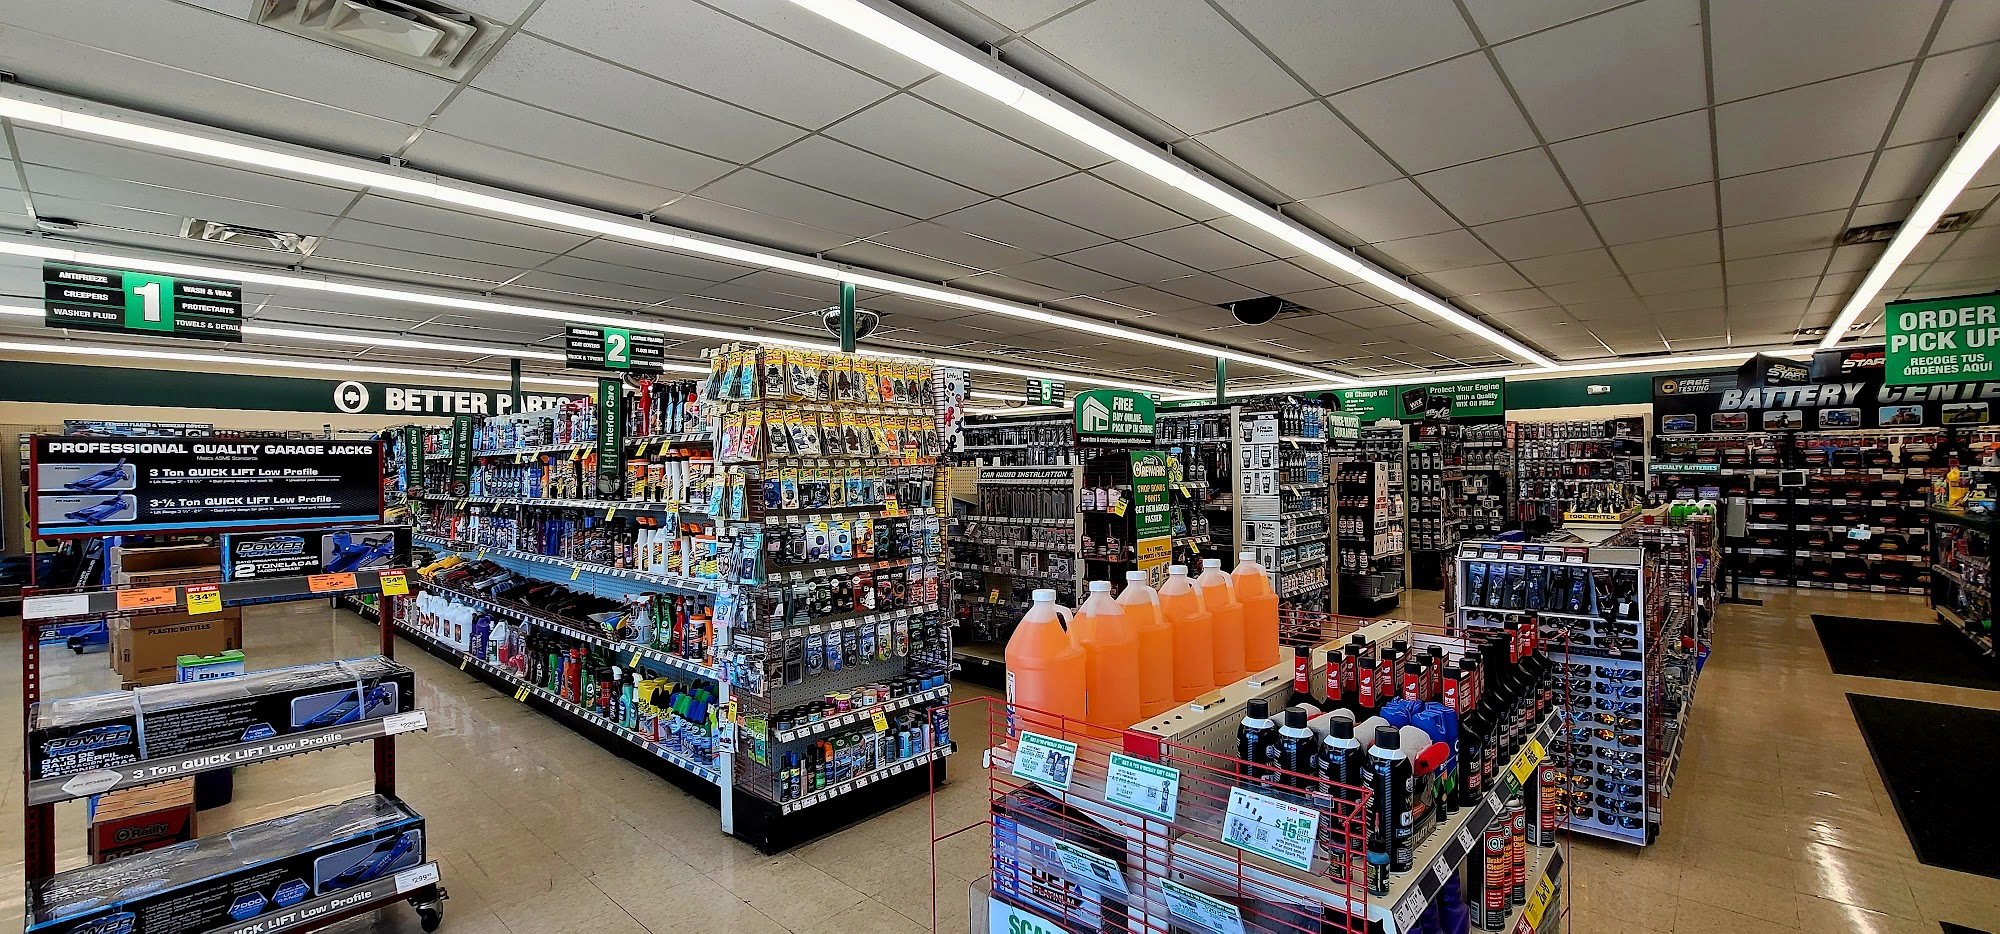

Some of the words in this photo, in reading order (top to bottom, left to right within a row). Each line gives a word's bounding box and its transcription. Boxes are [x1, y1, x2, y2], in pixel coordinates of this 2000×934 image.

[59, 271, 108, 283] ANTIFREEZE
[63, 290, 108, 301] CREEPERS
[183, 286, 206, 295] WASH
[215, 290, 232, 298] WAX
[133, 282, 160, 322] 1
[182, 303, 234, 314] PROTECTANTS
[53, 308, 91, 318] WASHER
[92, 311, 117, 320] FLUID
[1900, 305, 1996, 331] ORDER
[175, 319, 206, 328] TOWELS
[215, 323, 241, 332] DETAIL
[1891, 330, 1957, 353] PICK
[1966, 327, 2000, 347] UP
[607, 334, 626, 362] 2
[1841, 358, 1886, 368] STAR
[1911, 355, 1957, 366] RECOGE
[1960, 353, 1985, 362] TUS
[1767, 368, 1807, 379] START
[1904, 365, 1959, 376] ÓRDENES
[1962, 361, 1993, 372] AQUÍ
[1042, 384, 1051, 401] 5
[1430, 386, 1455, 394] Protect
[1475, 383, 1500, 391] Engine
[385, 387, 488, 413] BETTER
[605, 384, 615, 408] Care
[1719, 382, 1866, 410] BATTERY
[1877, 383, 2000, 403] CENTE
[1113, 396, 1133, 411] FREE
[1112, 412, 1123, 422] BUY
[605, 413, 614, 447] Interior
[1112, 423, 1124, 433] PICK
[1125, 424, 1132, 432] UP
[49, 442, 188, 454] PROFESSIONAL
[193, 444, 260, 455] QUALITY
[264, 445, 324, 455] GARAGE
[328, 445, 373, 455] JACKS
[150, 469, 159, 477] 3
[162, 469, 184, 477] Ton
[188, 469, 227, 477] QUICK
[283, 468, 318, 476] Profile
[1137, 485, 1150, 493] SHOP
[179, 498, 200, 507] Ton
[204, 497, 243, 505] QUICK
[273, 496, 295, 504] Low
[298, 495, 331, 503] Profile
[1145, 514, 1162, 523] FASTER
[236, 541, 304, 553] POWER
[235, 564, 255, 578] 2
[256, 560, 319, 569] TONELADAS
[148, 627, 178, 636] PLASTIC
[179, 623, 211, 632] BOTTLES
[47, 729, 131, 751] POWER
[79, 752, 119, 763] PERFIL
[132, 769, 144, 779] 3
[149, 764, 176, 777] Ton
[182, 752, 231, 770] QUICK
[235, 746, 265, 760] LIFT
[269, 741, 296, 753] Low
[300, 732, 342, 748] Profile
[114, 823, 168, 843] O'Reilly
[1275, 818, 1297, 839] $15
[1296, 835, 1311, 844] Card
[233, 897, 262, 911] 7000
[267, 911, 297, 929] LIFT
[300, 903, 328, 918] Low
[330, 889, 373, 909] Profile
